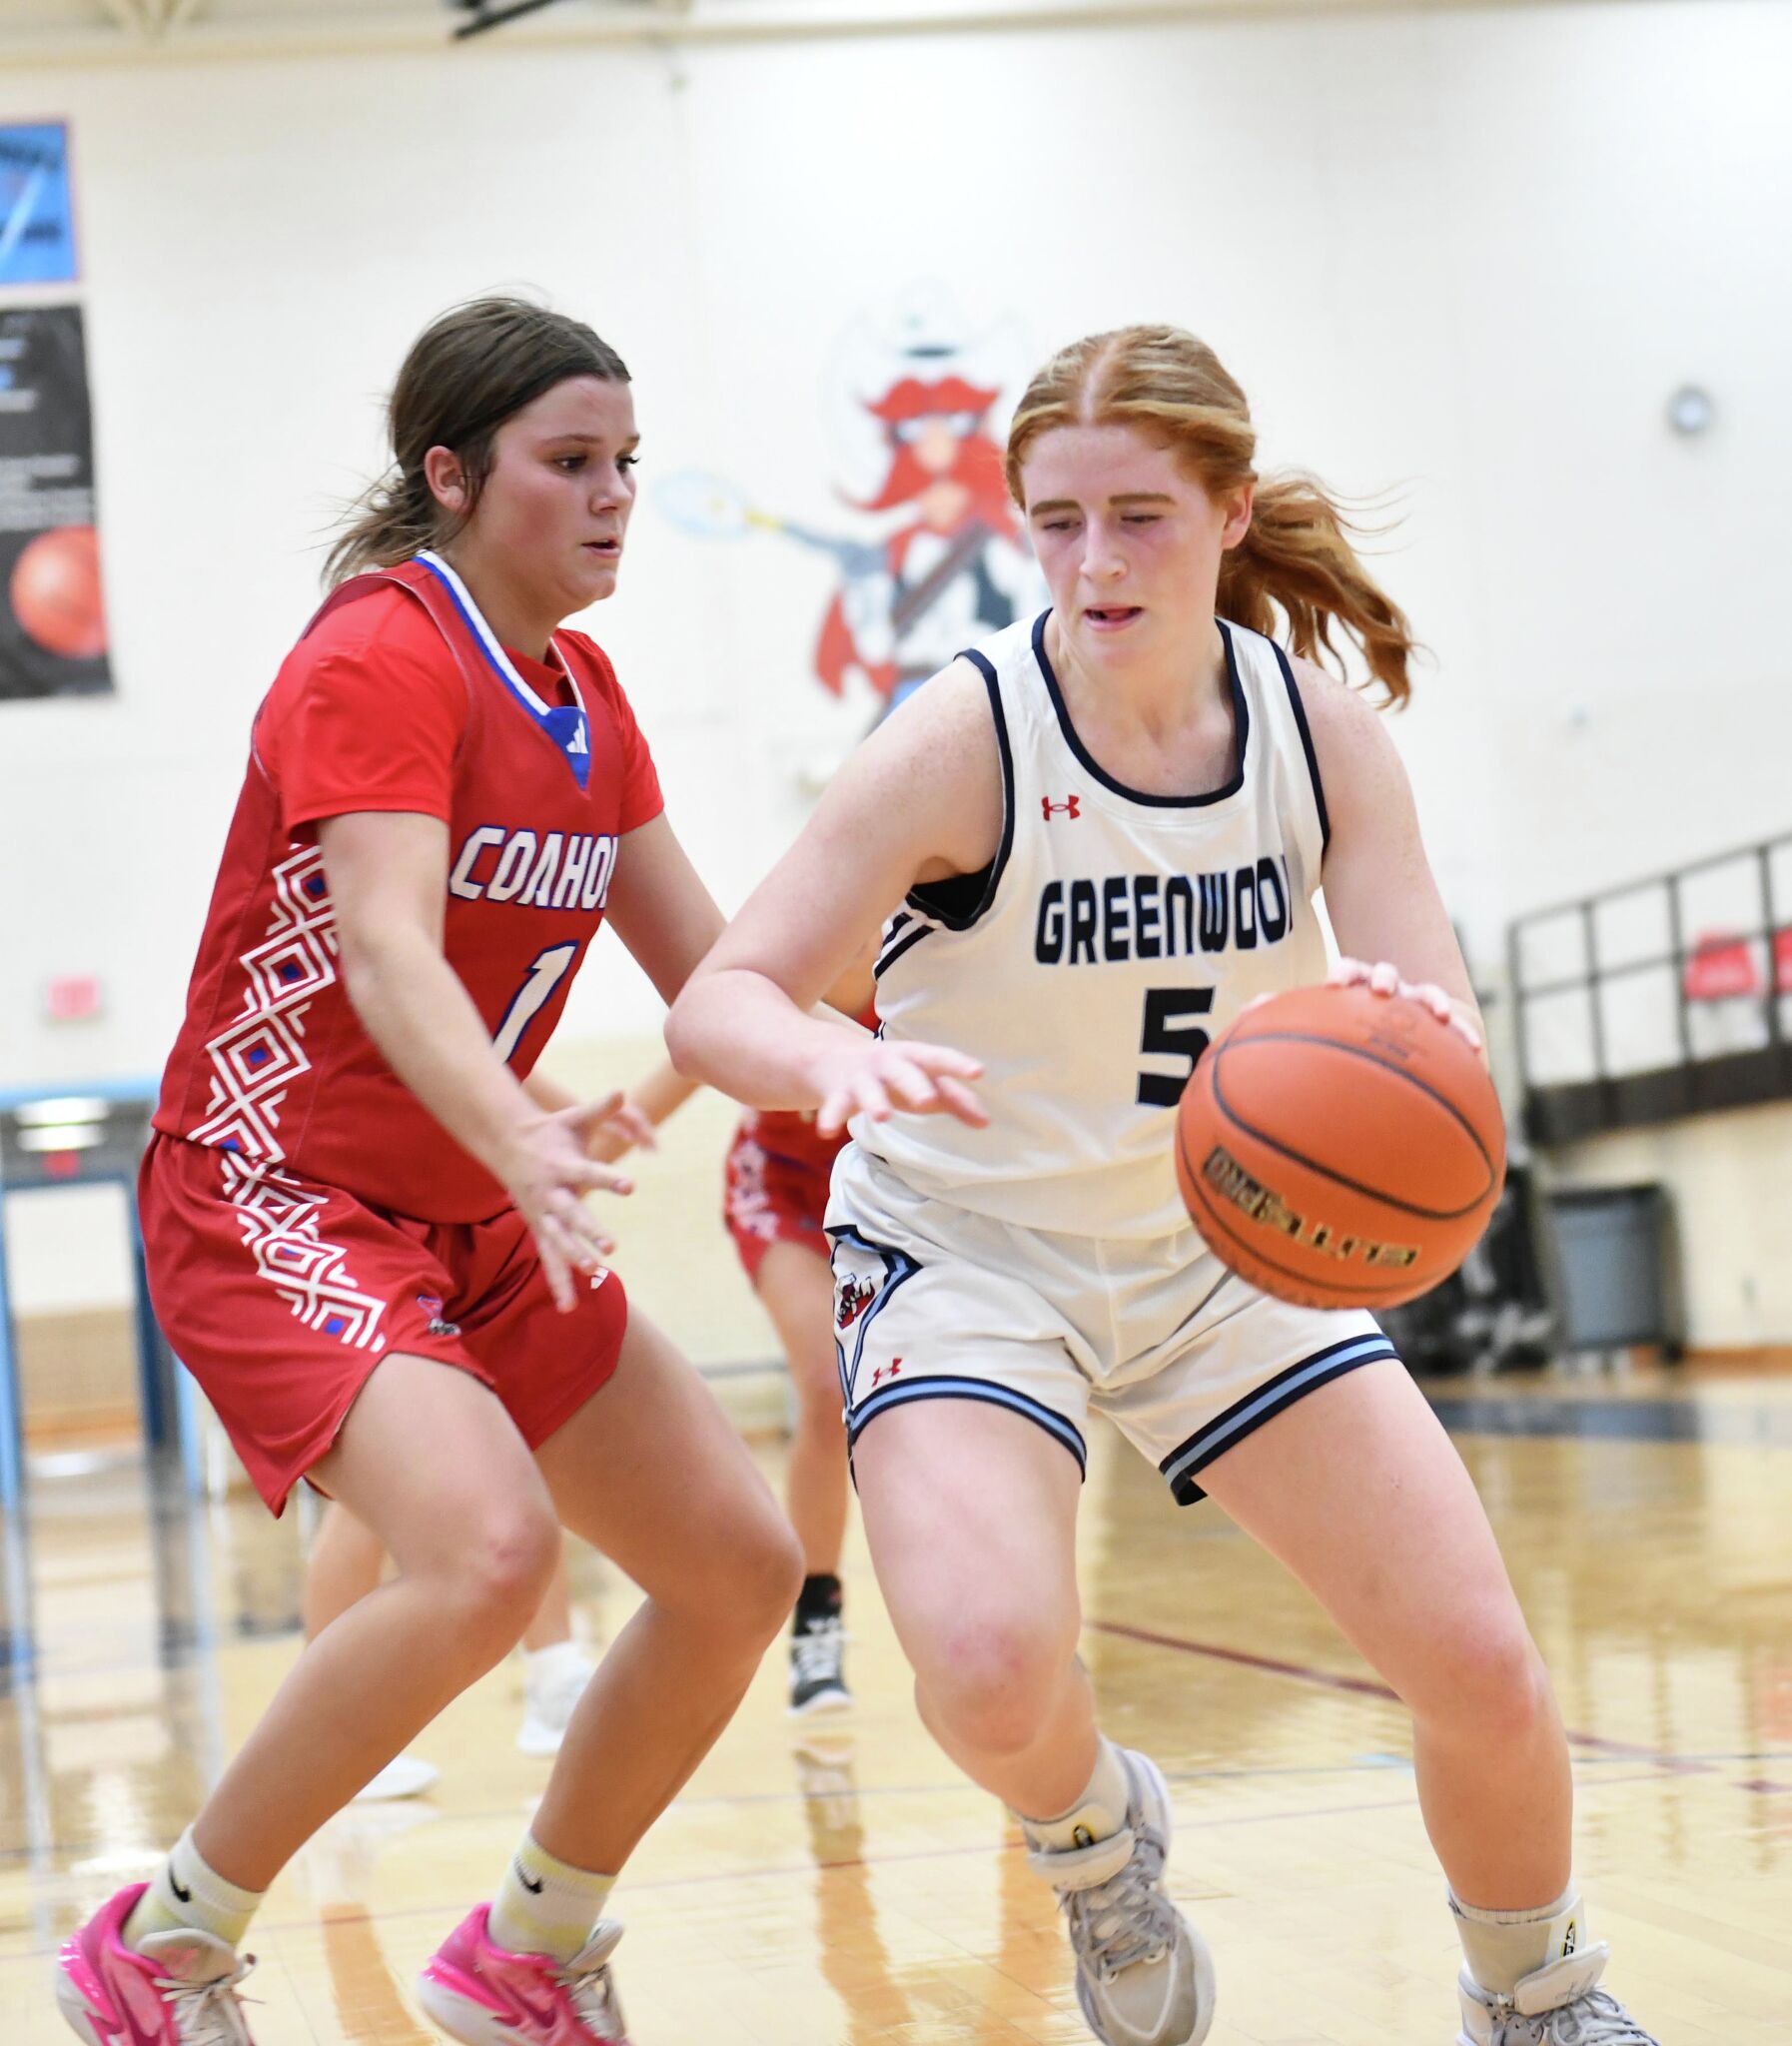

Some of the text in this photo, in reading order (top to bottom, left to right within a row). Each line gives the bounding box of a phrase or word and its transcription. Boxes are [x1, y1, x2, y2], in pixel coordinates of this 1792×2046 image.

[449, 824, 619, 911] COAHO
[1034, 854, 1293, 965] GREENWOO
[492, 939, 580, 1064] 1
[1135, 985, 1216, 1108] 5
